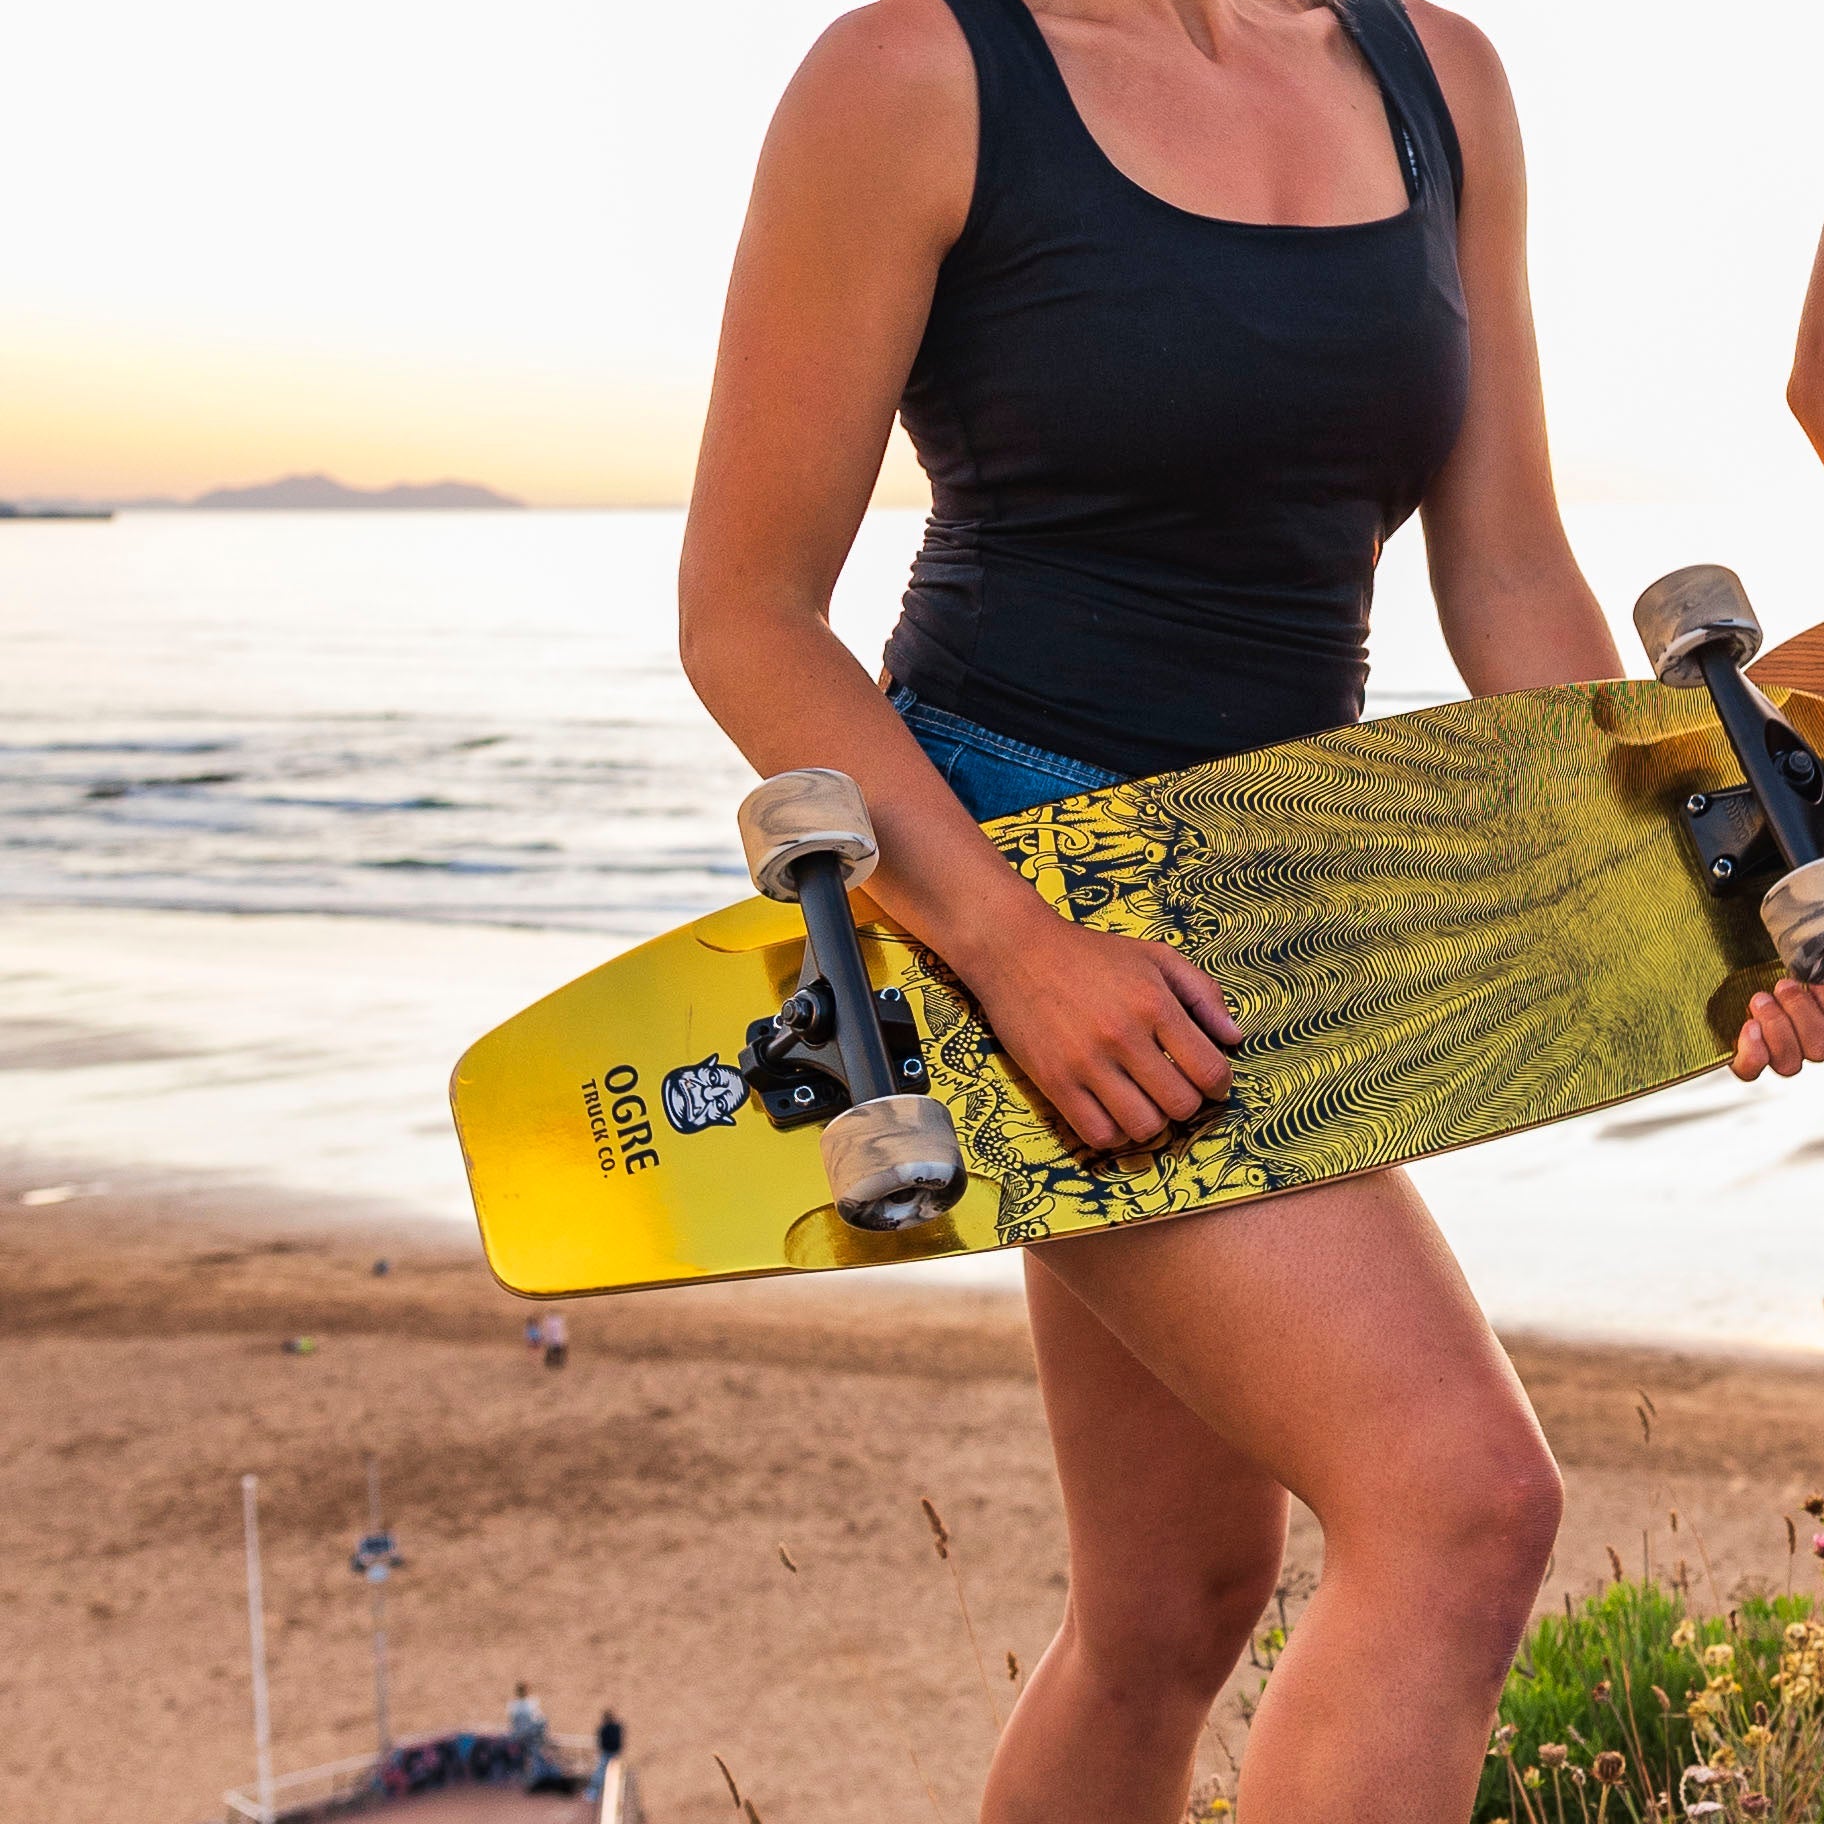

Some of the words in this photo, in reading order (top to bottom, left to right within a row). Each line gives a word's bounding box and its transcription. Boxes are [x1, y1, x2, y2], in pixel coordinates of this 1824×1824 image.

[581, 1078, 609, 1143] TRUCK
[598, 1146, 616, 1179] CO.
[604, 1064, 660, 1175] OGRE
